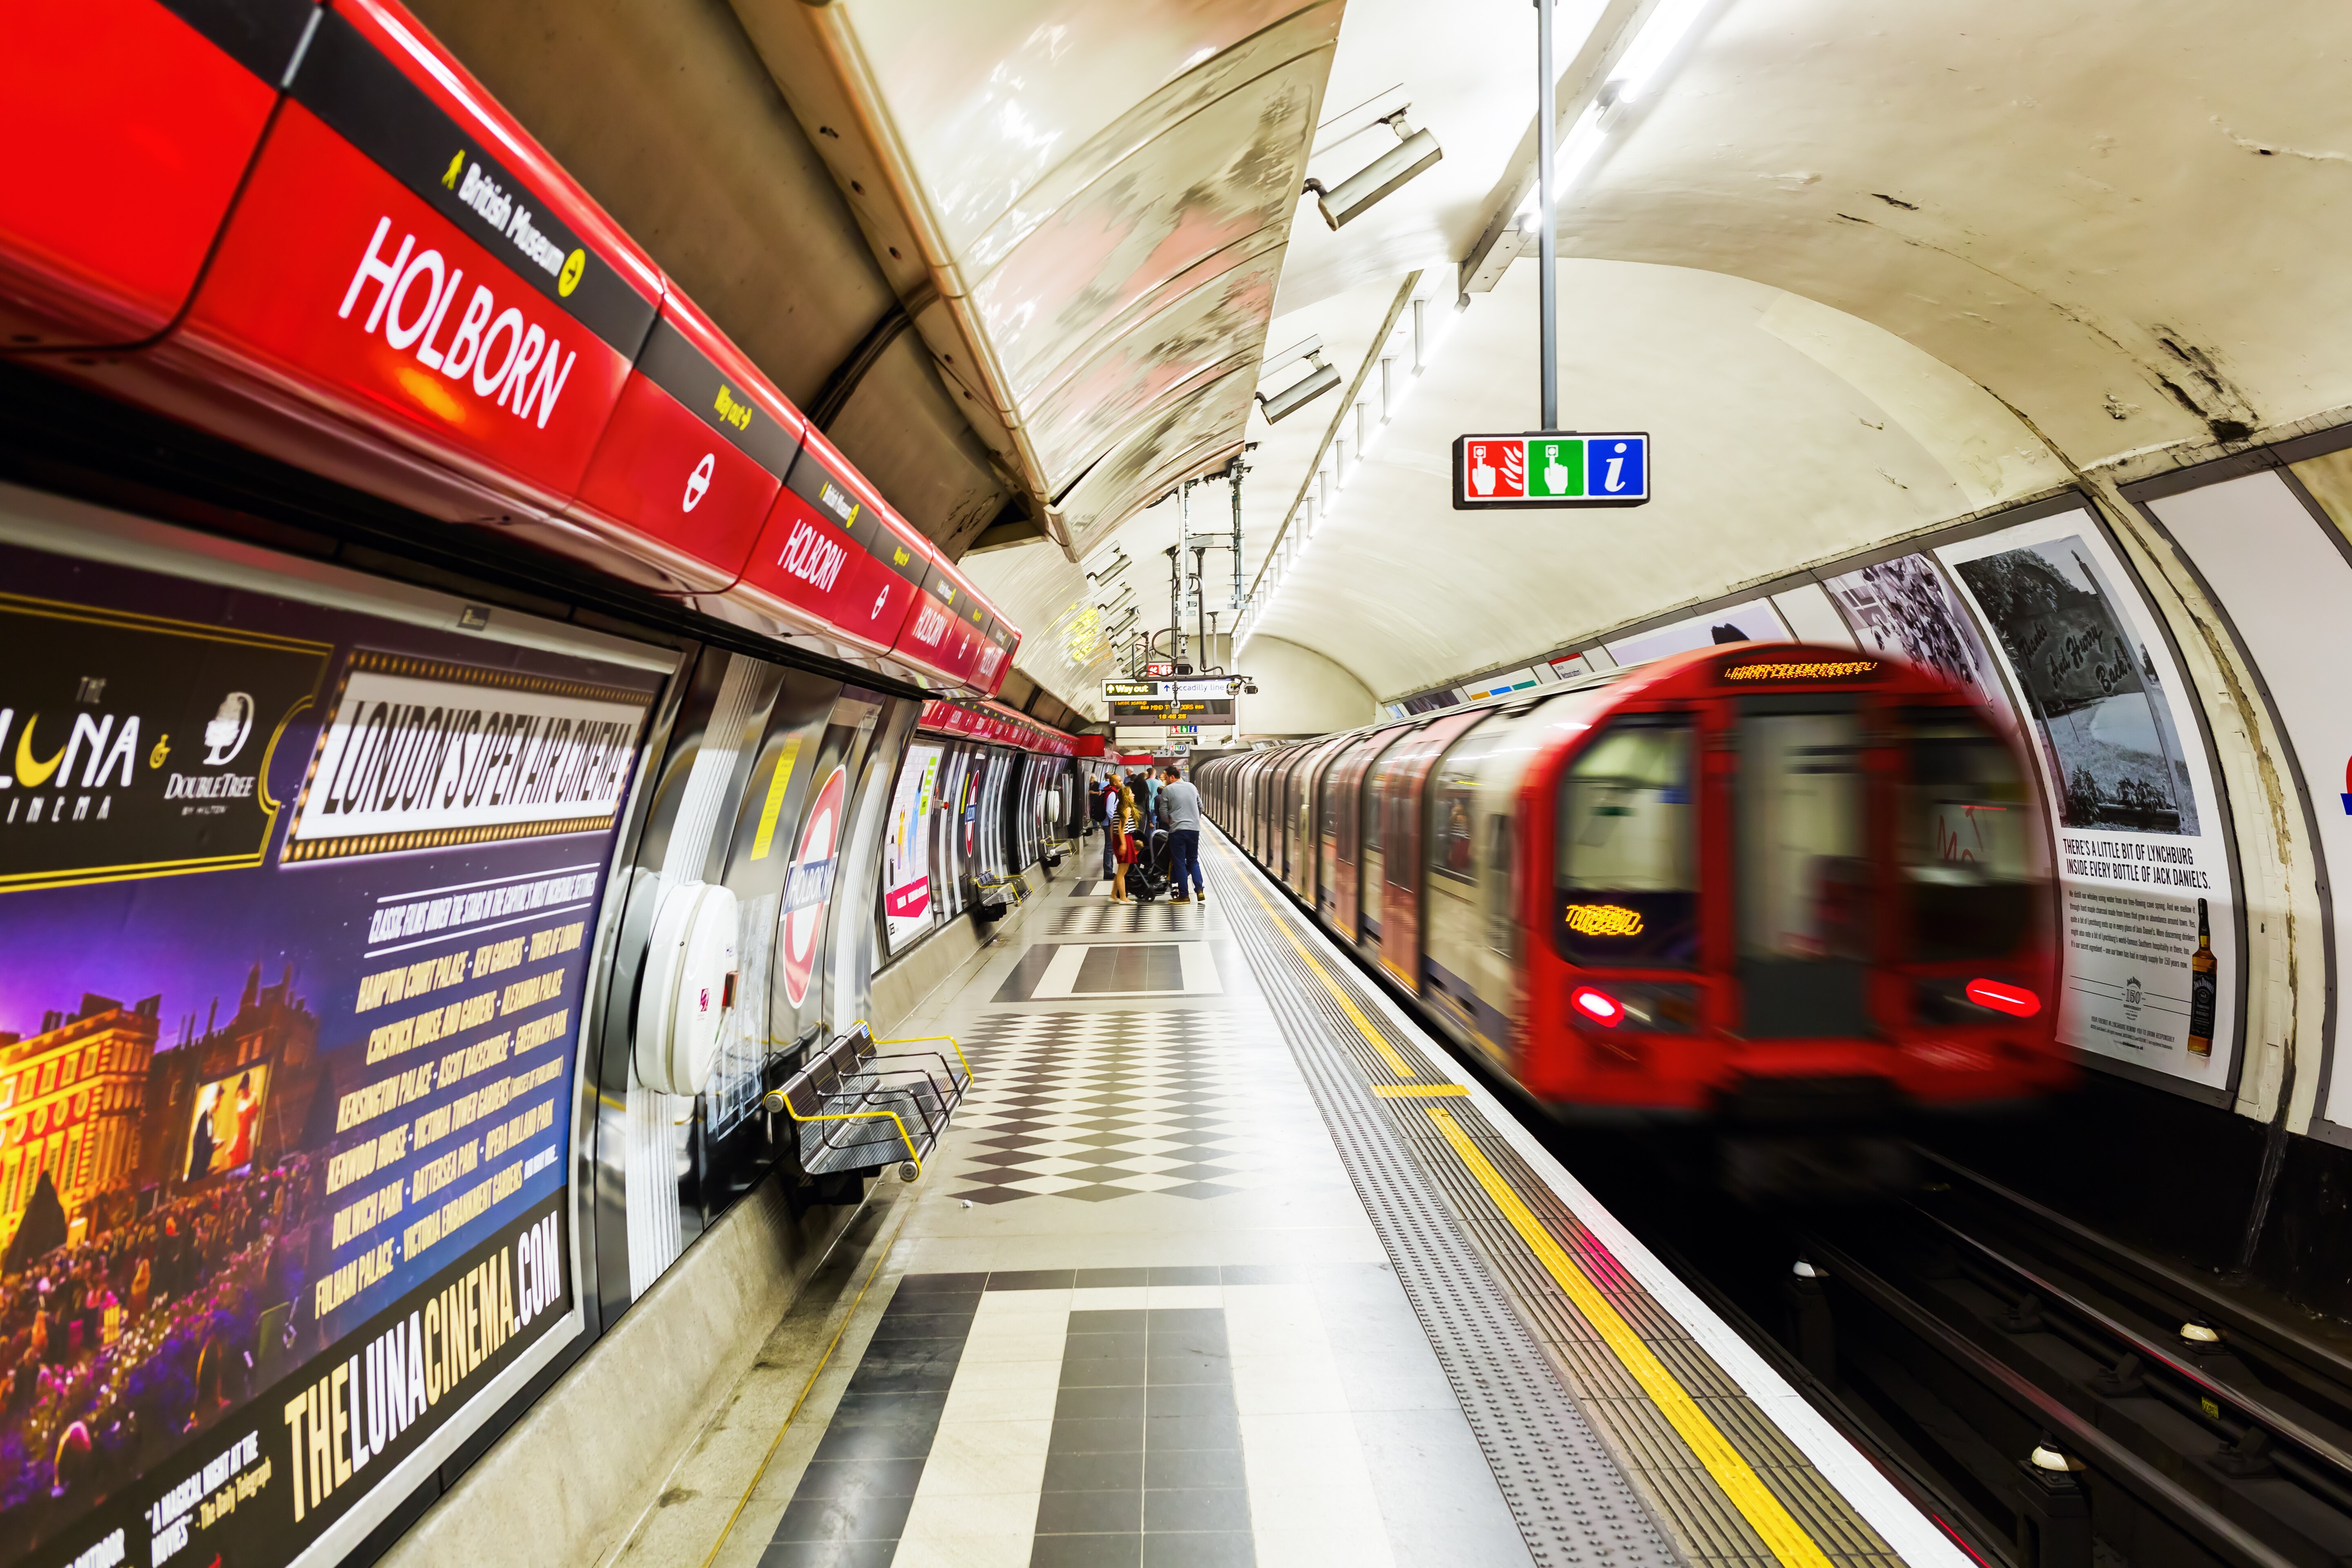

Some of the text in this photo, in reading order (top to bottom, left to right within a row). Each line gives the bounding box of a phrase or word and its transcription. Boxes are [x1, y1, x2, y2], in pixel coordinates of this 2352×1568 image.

[458, 162, 565, 277] British Museum
[339, 216, 576, 429] HOLBORN
[777, 519, 847, 593] HOLBORN
[911, 604, 948, 648] HOLBORN
[2018, 621, 2047, 670] Thanks
[2049, 624, 2103, 689] And Hurry
[1115, 685, 1133, 694] Way
[2095, 636, 2132, 693] Back!
[323, 700, 633, 815] LONDON'S OPEN AIR CINEMA
[7, 795, 111, 824] INEMA
[788, 864, 832, 908] HOLBORN
[2063, 838, 2194, 865] THERE'S A LITTLE BIT OF LYNCHBURG
[2067, 859, 2211, 889] INSIDE EVERY BOTTLE OF JACK DANIEL'S.
[365, 969, 565, 1066] CHISWICK HOUSE AND GARDENS ALEXANDRA PALACE
[331, 1098, 554, 1250] DULWICH PARK BATTERSEA PARK OPERA HOLLAND PARK
[314, 1259, 357, 1322] FULHAM
[357, 1236, 394, 1293] PALACE
[403, 1209, 441, 1264] VICTORIA
[441, 1178, 493, 1240] EMBANKMENT
[492, 1159, 523, 1207] GARDENS
[285, 1211, 561, 1523] THELUNACINEMA.COM
[161, 1472, 203, 1526] MAGICAL
[203, 1450, 230, 1495] NIGHT
[230, 1442, 242, 1476] AT
[242, 1430, 258, 1465] THE
[200, 1456, 272, 1530] The Daily Telegraph
